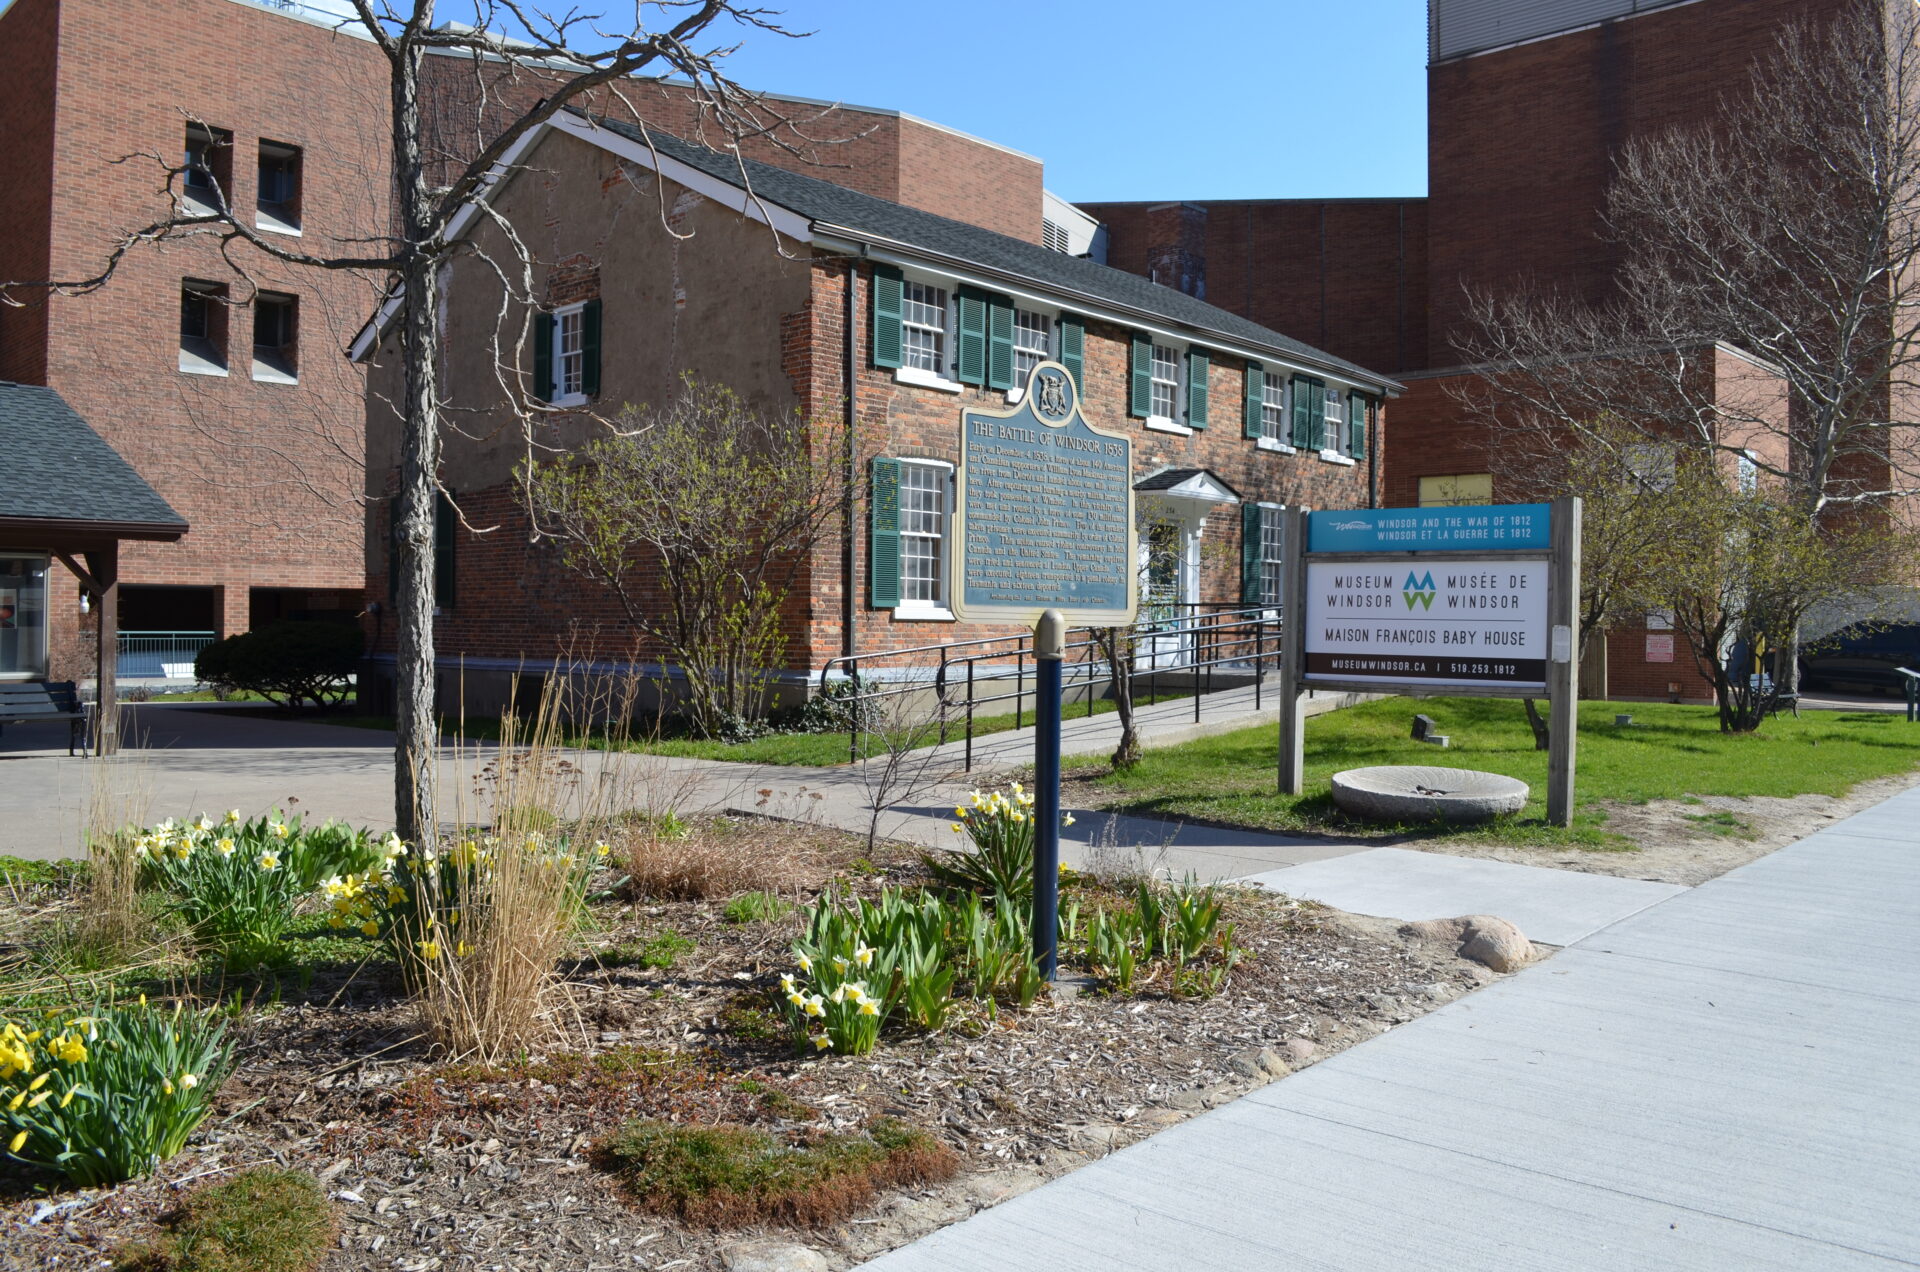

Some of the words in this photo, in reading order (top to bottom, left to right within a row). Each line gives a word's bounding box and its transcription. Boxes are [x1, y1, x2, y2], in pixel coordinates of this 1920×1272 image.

[973, 421, 994, 437] THE
[999, 425, 1035, 443] BATTLE
[1039, 431, 1052, 446] OF
[1055, 434, 1100, 453] WINDSOR
[1104, 442, 1123, 458] 1838
[1377, 519, 1417, 529] WINDSOR
[1422, 518, 1439, 528] AND
[1445, 518, 1462, 527] THE
[1467, 517, 1488, 527] WAR
[1493, 516, 1505, 526] OF
[1510, 516, 1531, 525] 1812
[1377, 531, 1417, 540] WINDSOR
[1421, 530, 1431, 539] ET
[1438, 530, 1448, 539] LA
[1454, 529, 1489, 539] GUERRE
[1494, 529, 1505, 538] DE
[1511, 528, 1531, 538] 1812
[1335, 576, 1393, 588] MUSEUM
[1448, 572, 1497, 588] MUSÉE
[1509, 575, 1527, 588] DE
[1327, 595, 1392, 608] WINDSOR
[1448, 595, 1519, 609] WINDSOR
[1325, 629, 1369, 642] MAISON
[1376, 629, 1435, 646] FRANÇOIS
[1443, 631, 1477, 644] BABY
[1485, 632, 1526, 645] HOUSE
[1332, 660, 1426, 671] MUSEUMWINDSOR.CA
[1451, 664, 1516, 675] 519.253.1812
